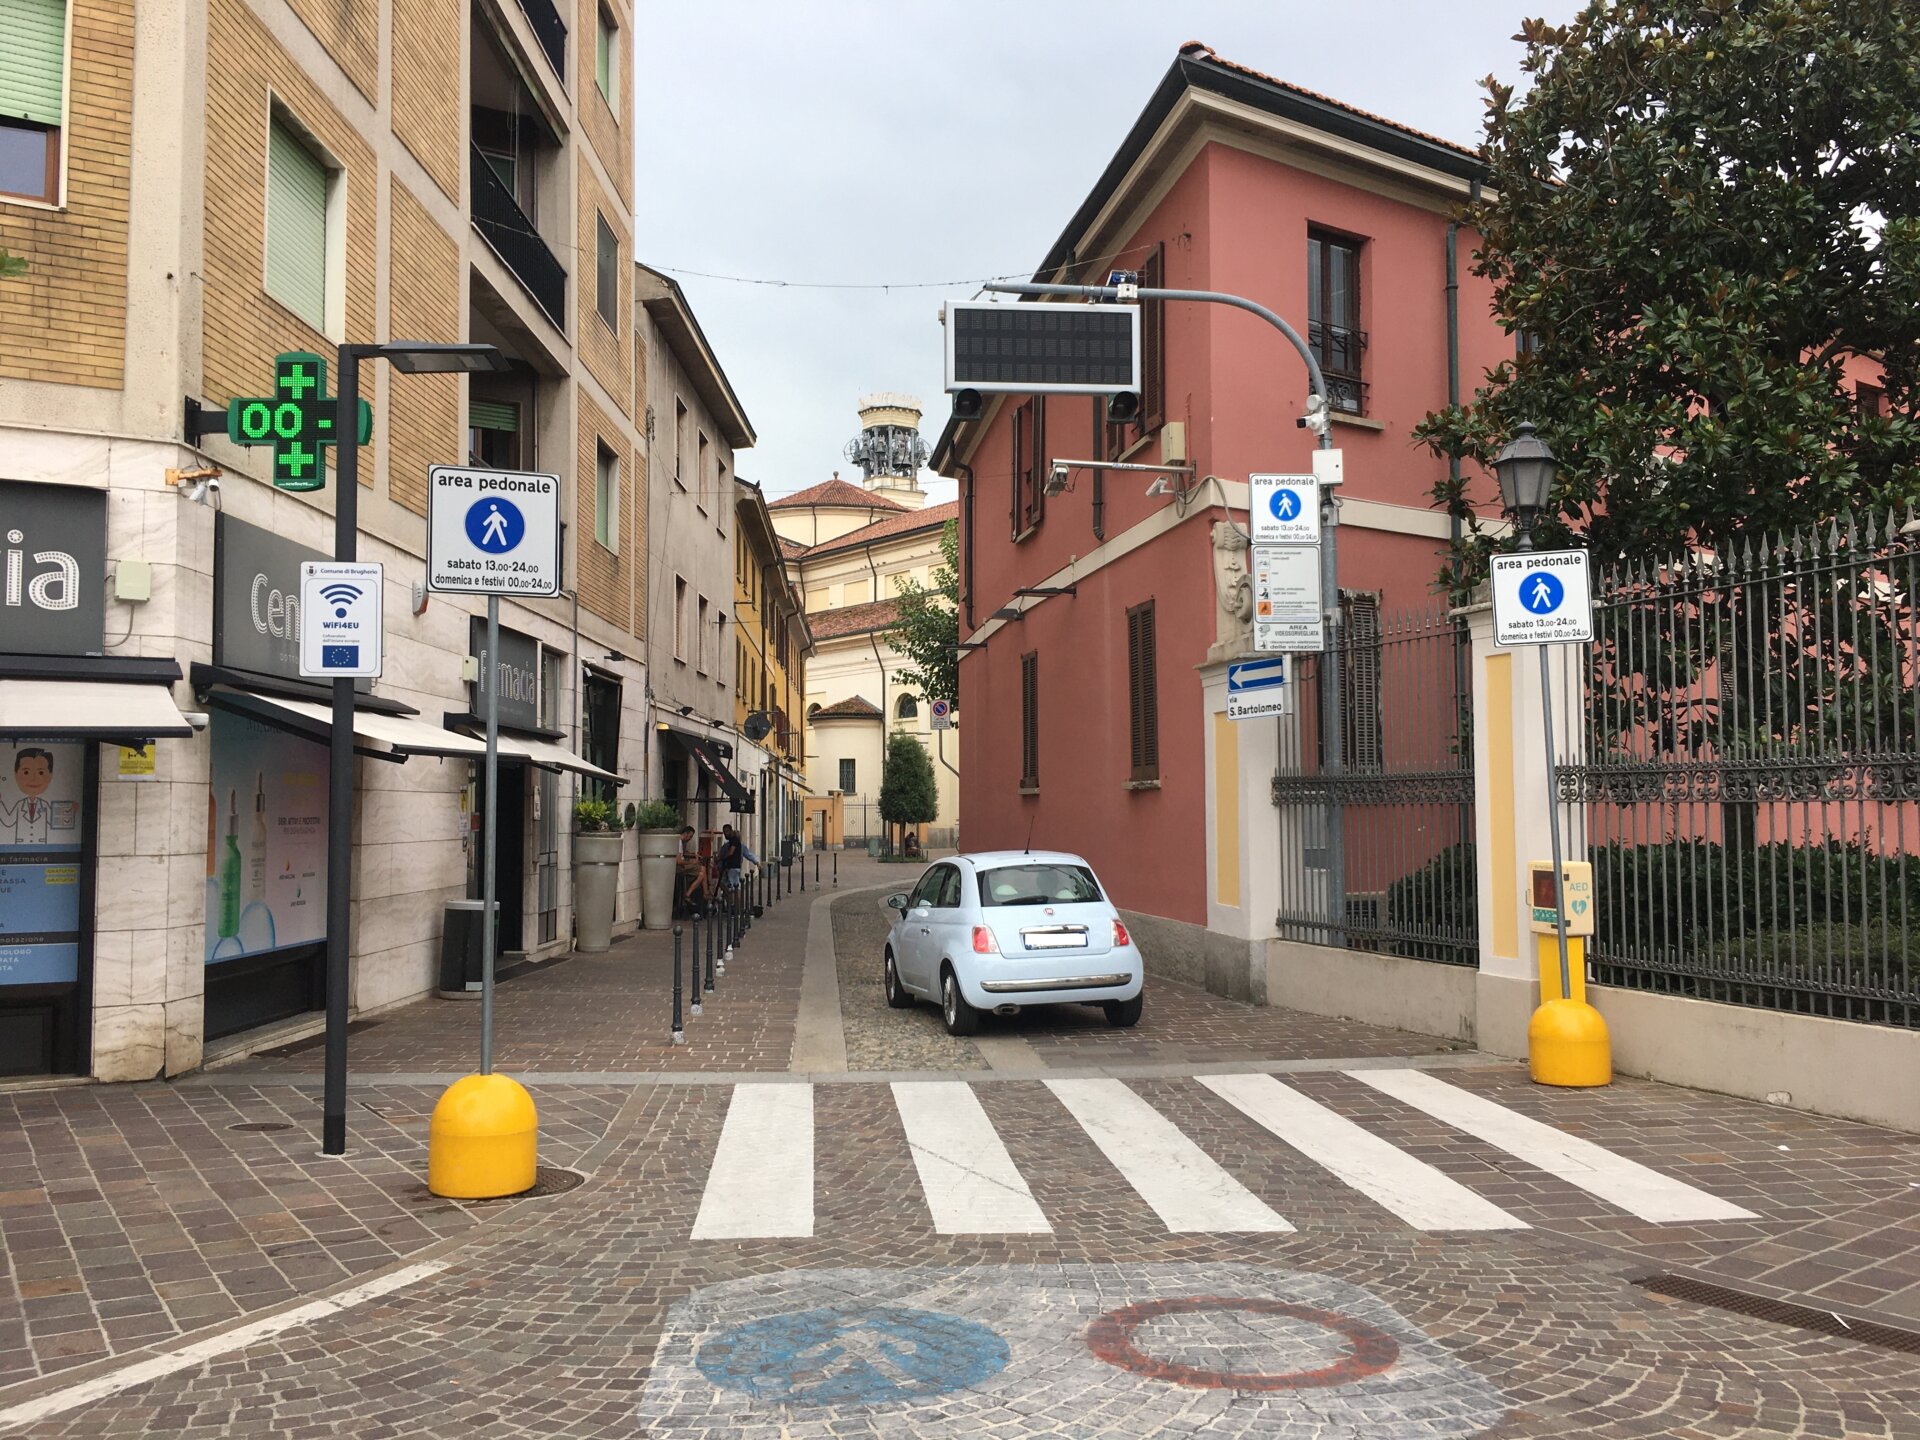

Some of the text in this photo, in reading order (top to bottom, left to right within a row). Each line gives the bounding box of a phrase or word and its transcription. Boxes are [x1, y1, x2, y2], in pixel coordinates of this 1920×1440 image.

[438, 474, 551, 493] area pedonale
[1254, 476, 1315, 487] area pedonale
[447, 559, 539, 573] sabato 13.00-24.00
[1497, 554, 1581, 570] area pedonale
[0, 529, 80, 611] ia
[435, 574, 552, 590] domenica e festivi 00.00-24.00
[251, 573, 301, 642] Cen
[322, 621, 359, 629] WiFi4EU
[1508, 619, 1534, 629] sabato
[1500, 631, 1528, 641] domenica
[1534, 630, 1552, 639] festivi
[1229, 703, 1282, 717] S. Bartolomeo
[8, 855, 49, 863] farmacia
[1569, 882, 1588, 892] AED
